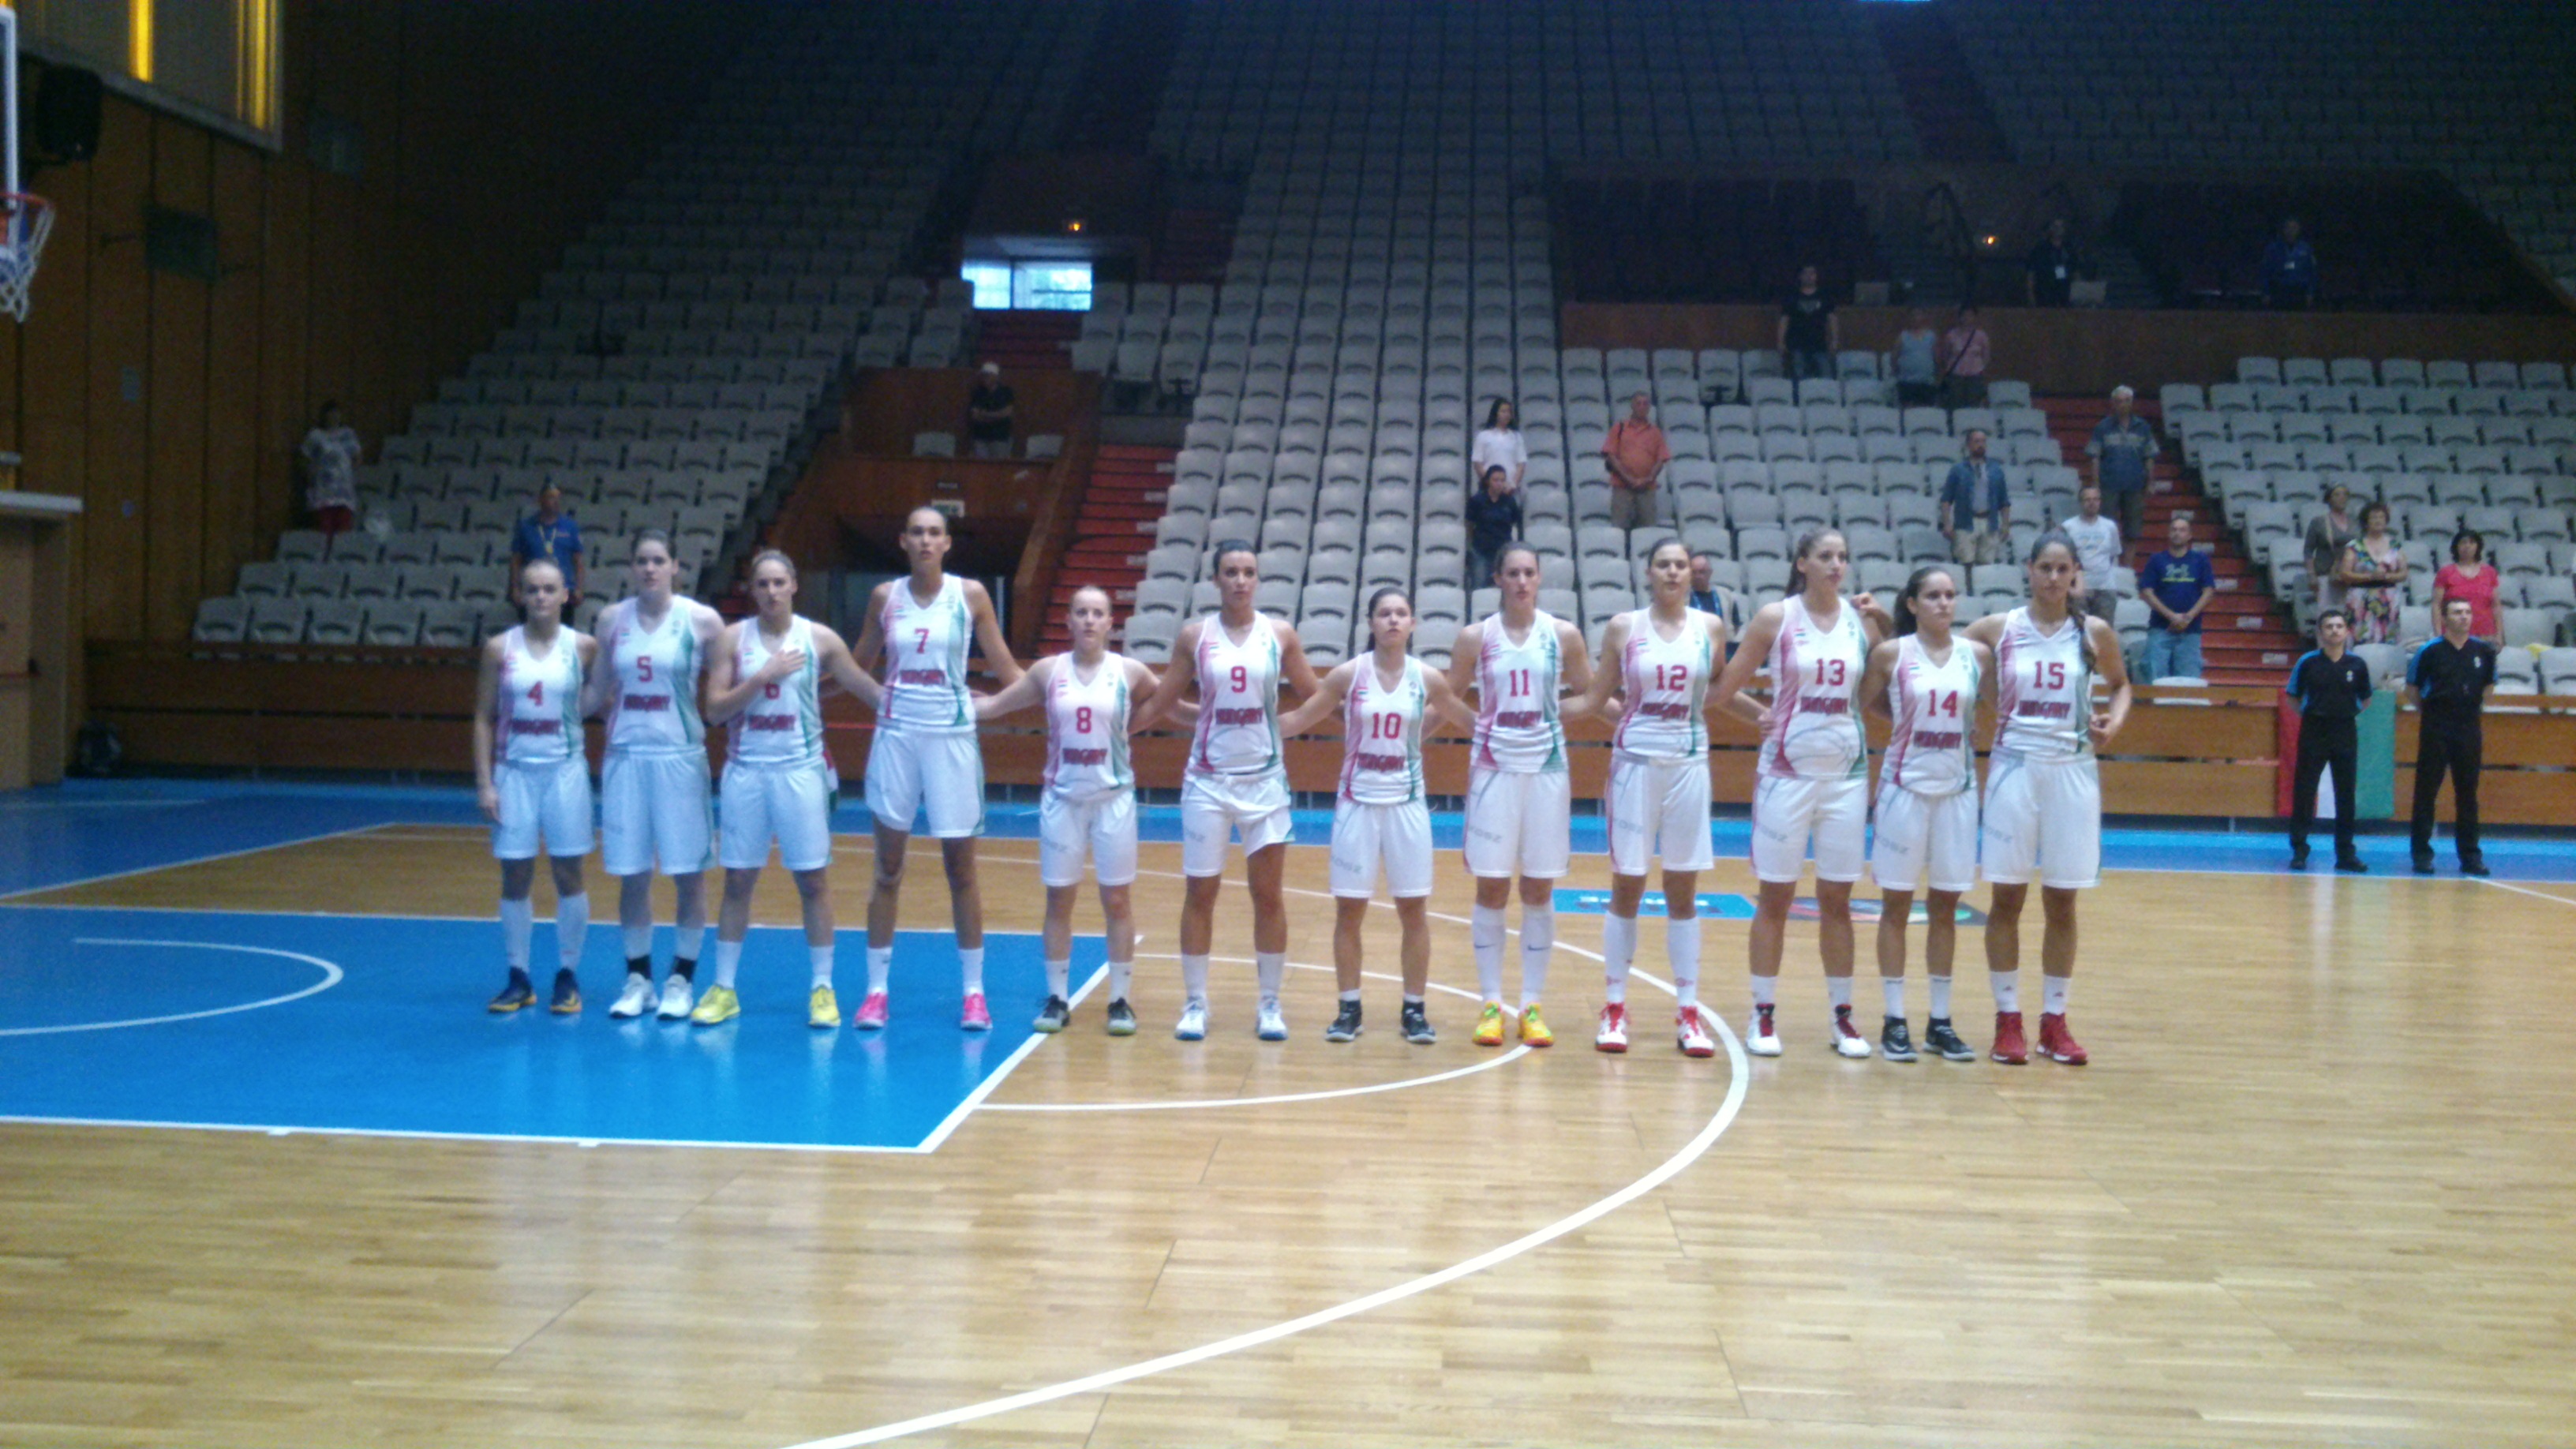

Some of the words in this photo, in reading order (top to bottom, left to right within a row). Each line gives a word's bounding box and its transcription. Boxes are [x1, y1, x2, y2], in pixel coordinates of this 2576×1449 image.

[914, 628, 930, 654] 7
[637, 656, 653, 683] 5
[1230, 665, 1246, 693] 9
[1509, 668, 1530, 697] 11
[1656, 664, 1687, 691] 12
[1816, 658, 1845, 686] 13
[2033, 661, 2065, 691] 15
[526, 680, 544, 706] 4
[1928, 689, 1958, 718] 14
[1076, 706, 1091, 734] 8
[1372, 712, 1402, 739] 10
